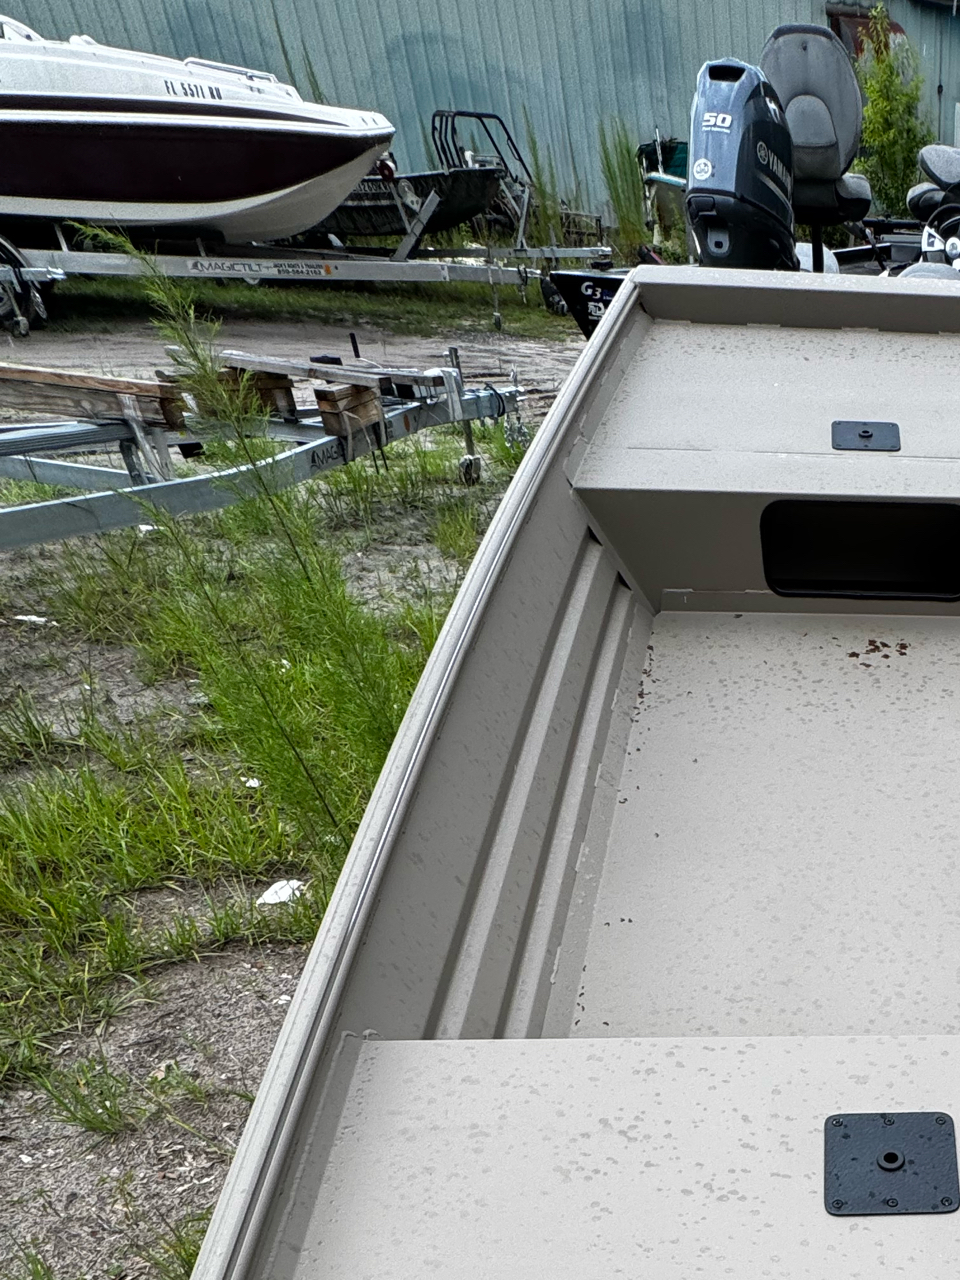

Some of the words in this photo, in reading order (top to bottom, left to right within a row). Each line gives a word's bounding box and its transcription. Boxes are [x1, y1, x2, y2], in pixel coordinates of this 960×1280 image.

[164, 80, 178, 95] FL
[701, 112, 732, 128] 50
[200, 261, 263, 273] MAGICTILT
[580, 281, 602, 299] G3
